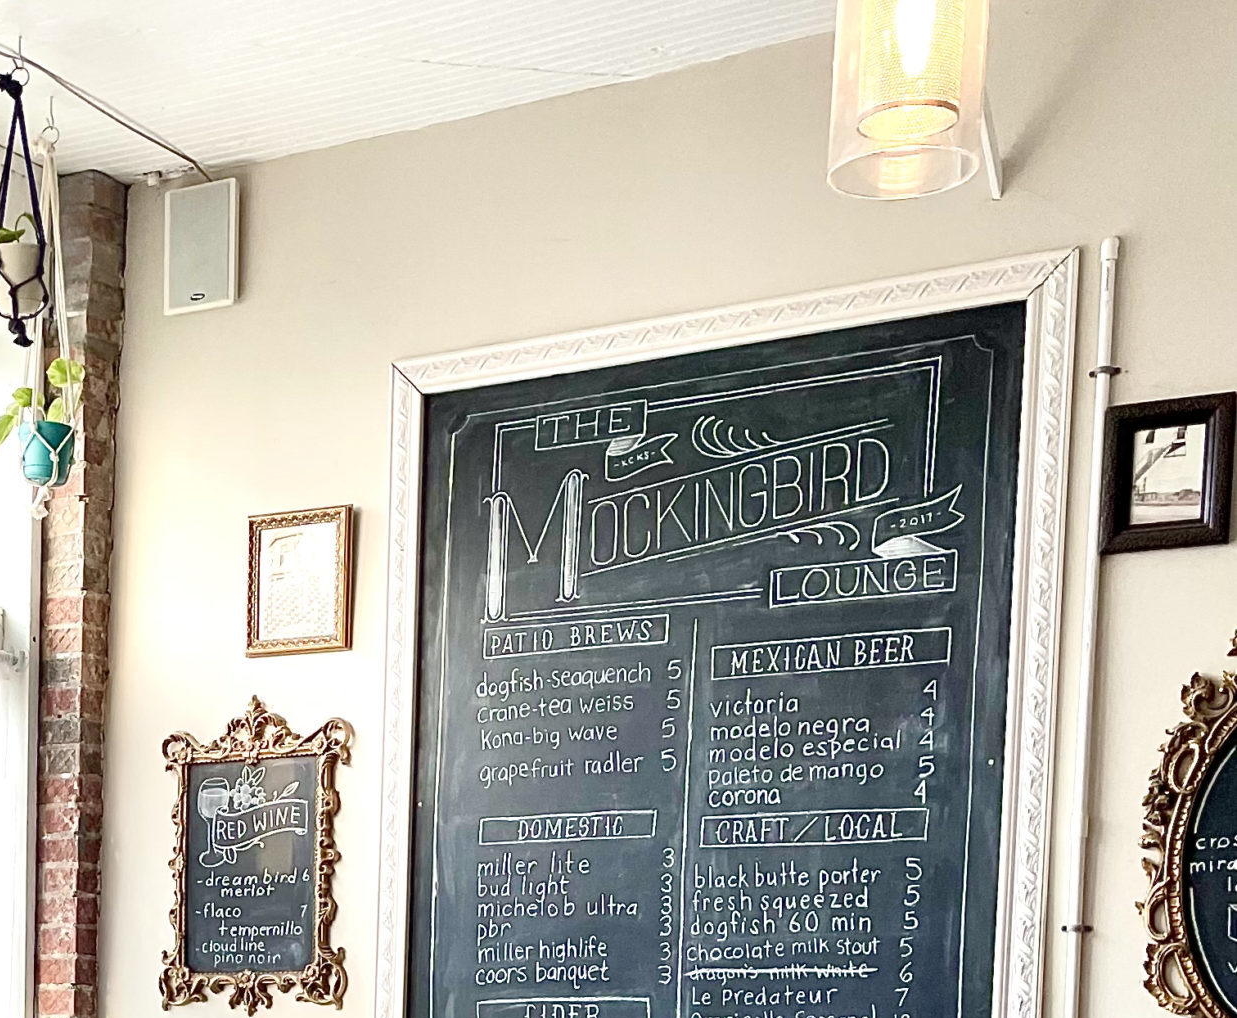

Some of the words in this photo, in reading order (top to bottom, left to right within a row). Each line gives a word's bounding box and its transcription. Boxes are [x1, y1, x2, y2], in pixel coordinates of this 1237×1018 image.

[541, 407, 632, 445] THE
[481, 439, 890, 624] MOCKINGBIRD
[775, 556, 944, 600] LOUNGE
[491, 629, 553, 655] PATIO
[570, 620, 653, 647] BREWS
[731, 641, 841, 675] MEXICAN
[854, 635, 914, 666] BEER
[667, 659, 682, 680] 5
[580, 695, 633, 714] weiss
[666, 689, 681, 710] 5
[711, 688, 799, 718] victoria
[923, 680, 937, 700] 4
[569, 724, 618, 741] wave
[662, 718, 675, 739] 5
[711, 716, 791, 740] modelo
[797, 717, 870, 740] negra
[921, 707, 935, 726] 4
[710, 738, 794, 762] modelo
[803, 730, 901, 759] especial
[919, 731, 933, 750] 4
[479, 758, 574, 789] grapefruit
[585, 751, 644, 774] radler
[661, 749, 676, 772] 5
[708, 767, 773, 789] paleto
[780, 764, 803, 782] de
[809, 764, 884, 785] mango
[919, 756, 935, 778] 5
[708, 788, 781, 807] corona
[914, 780, 926, 804] 4
[216, 820, 247, 841] RED
[252, 806, 301, 832] WINE
[518, 816, 623, 840] DOMESTIC
[716, 817, 789, 843] CRAFT
[824, 812, 902, 841] LOCAL
[263, 867, 297, 884] bird
[303, 869, 310, 881] 6
[477, 853, 537, 876] miller
[551, 851, 590, 874] lite
[663, 848, 674, 868] 3
[695, 863, 748, 888] black
[755, 860, 809, 887] butte
[819, 857, 881, 893] porter
[906, 858, 922, 881] 5
[221, 884, 274, 897] merlot
[478, 875, 511, 897] bud
[522, 874, 569, 902] light
[661, 874, 672, 893] 3
[692, 889, 752, 912] fresh
[761, 886, 868, 918] squeezed
[904, 885, 920, 906] 5
[301, 904, 307, 918] 7
[477, 895, 575, 918] michelob
[587, 894, 638, 915] ultra
[661, 896, 672, 915] 3
[219, 920, 302, 941] tempernillo
[477, 920, 511, 946] pbr
[660, 915, 671, 936] 3
[691, 909, 775, 941] dogfish
[789, 911, 818, 932] 60
[831, 913, 871, 932] min
[904, 911, 918, 930] 5
[241, 937, 265, 951] line
[478, 942, 533, 963] miller
[540, 936, 607, 963] highlife
[661, 943, 671, 961] 3
[687, 940, 784, 961] chocolate
[792, 938, 829, 956] milk
[837, 938, 880, 956] stout
[900, 937, 912, 957] 5
[214, 952, 243, 967] pino
[249, 952, 280, 964] noir
[899, 962, 912, 982] 6
[476, 967, 527, 985] coors
[536, 961, 609, 989] banquet
[658, 966, 671, 985] 3
[692, 988, 711, 1005] Le
[895, 988, 909, 1006] 7
